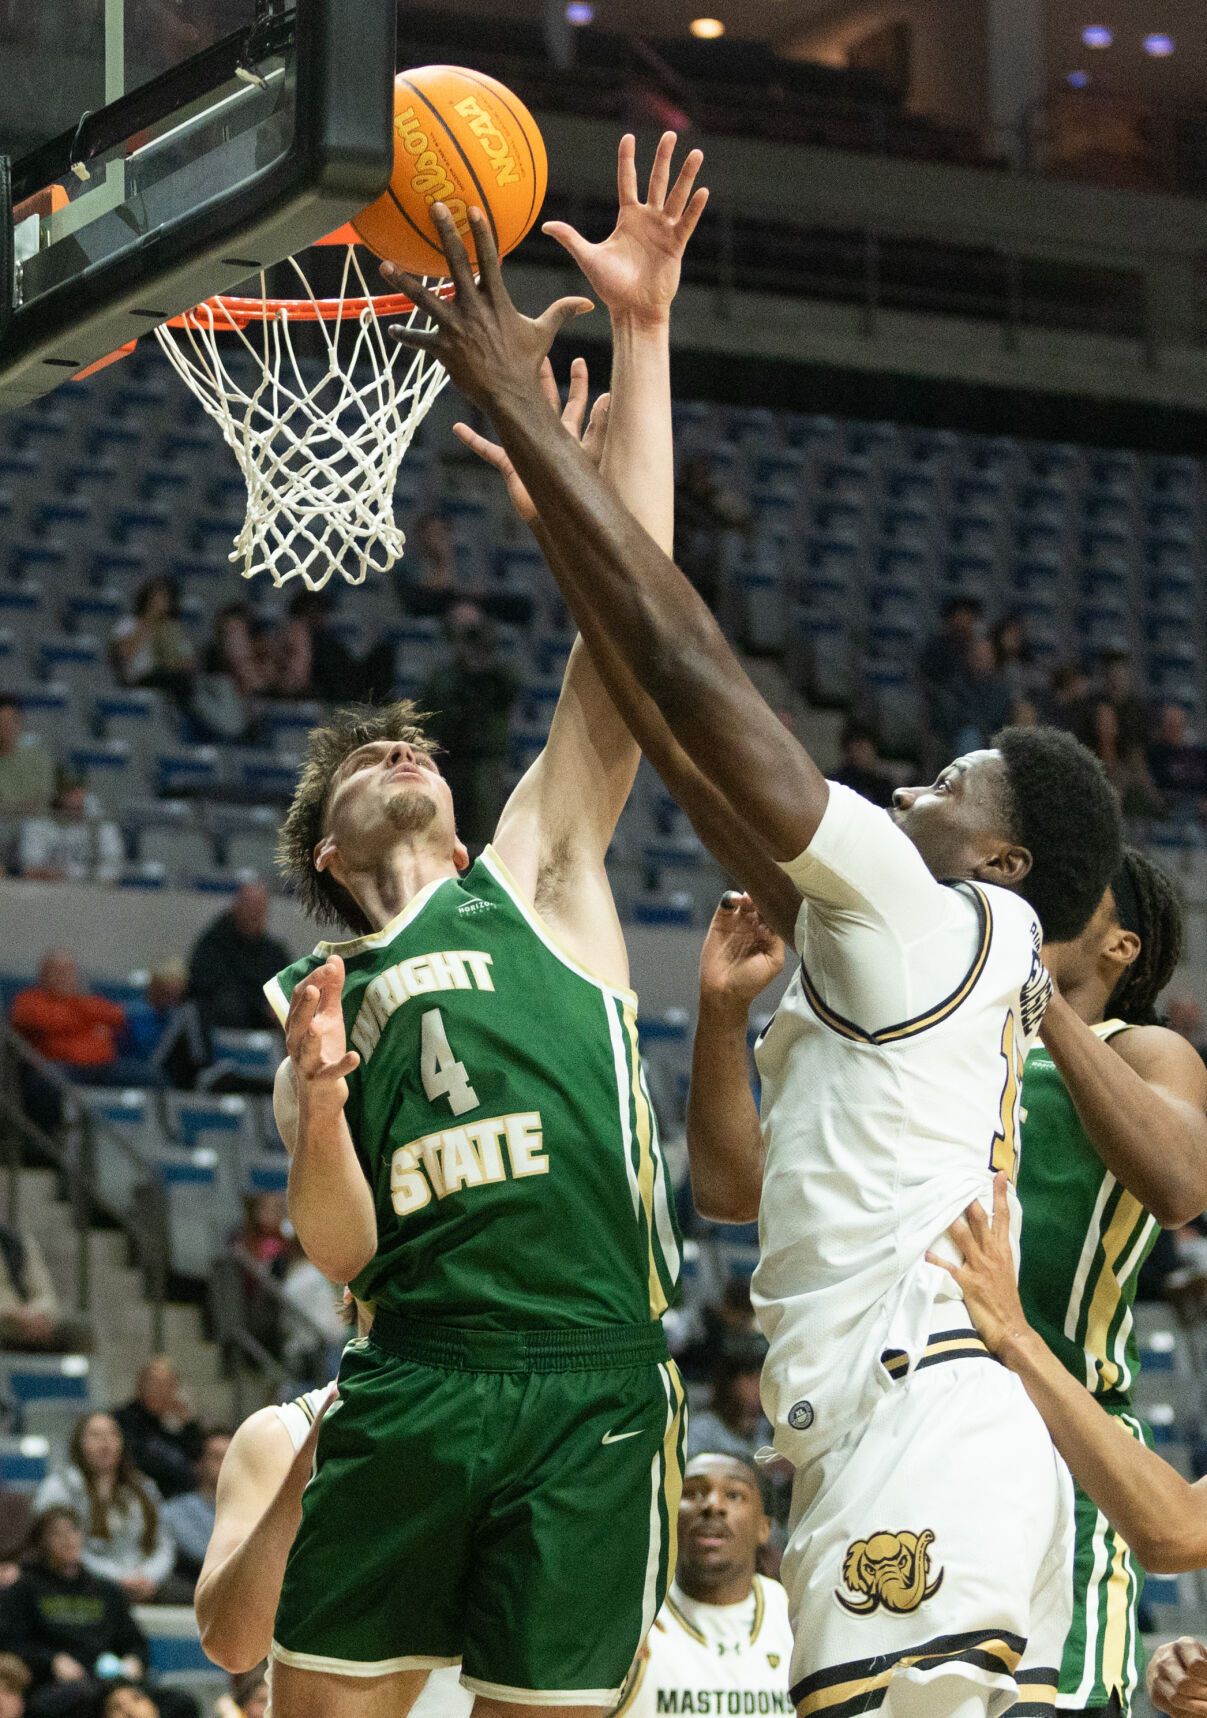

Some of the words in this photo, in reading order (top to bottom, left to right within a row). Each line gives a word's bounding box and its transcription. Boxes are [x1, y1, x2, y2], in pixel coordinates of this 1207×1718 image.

[454, 95, 520, 187] NCAA
[351, 950, 496, 1065] WRIGHT
[420, 1007, 480, 1117] 4
[390, 1111, 550, 1217] STATE
